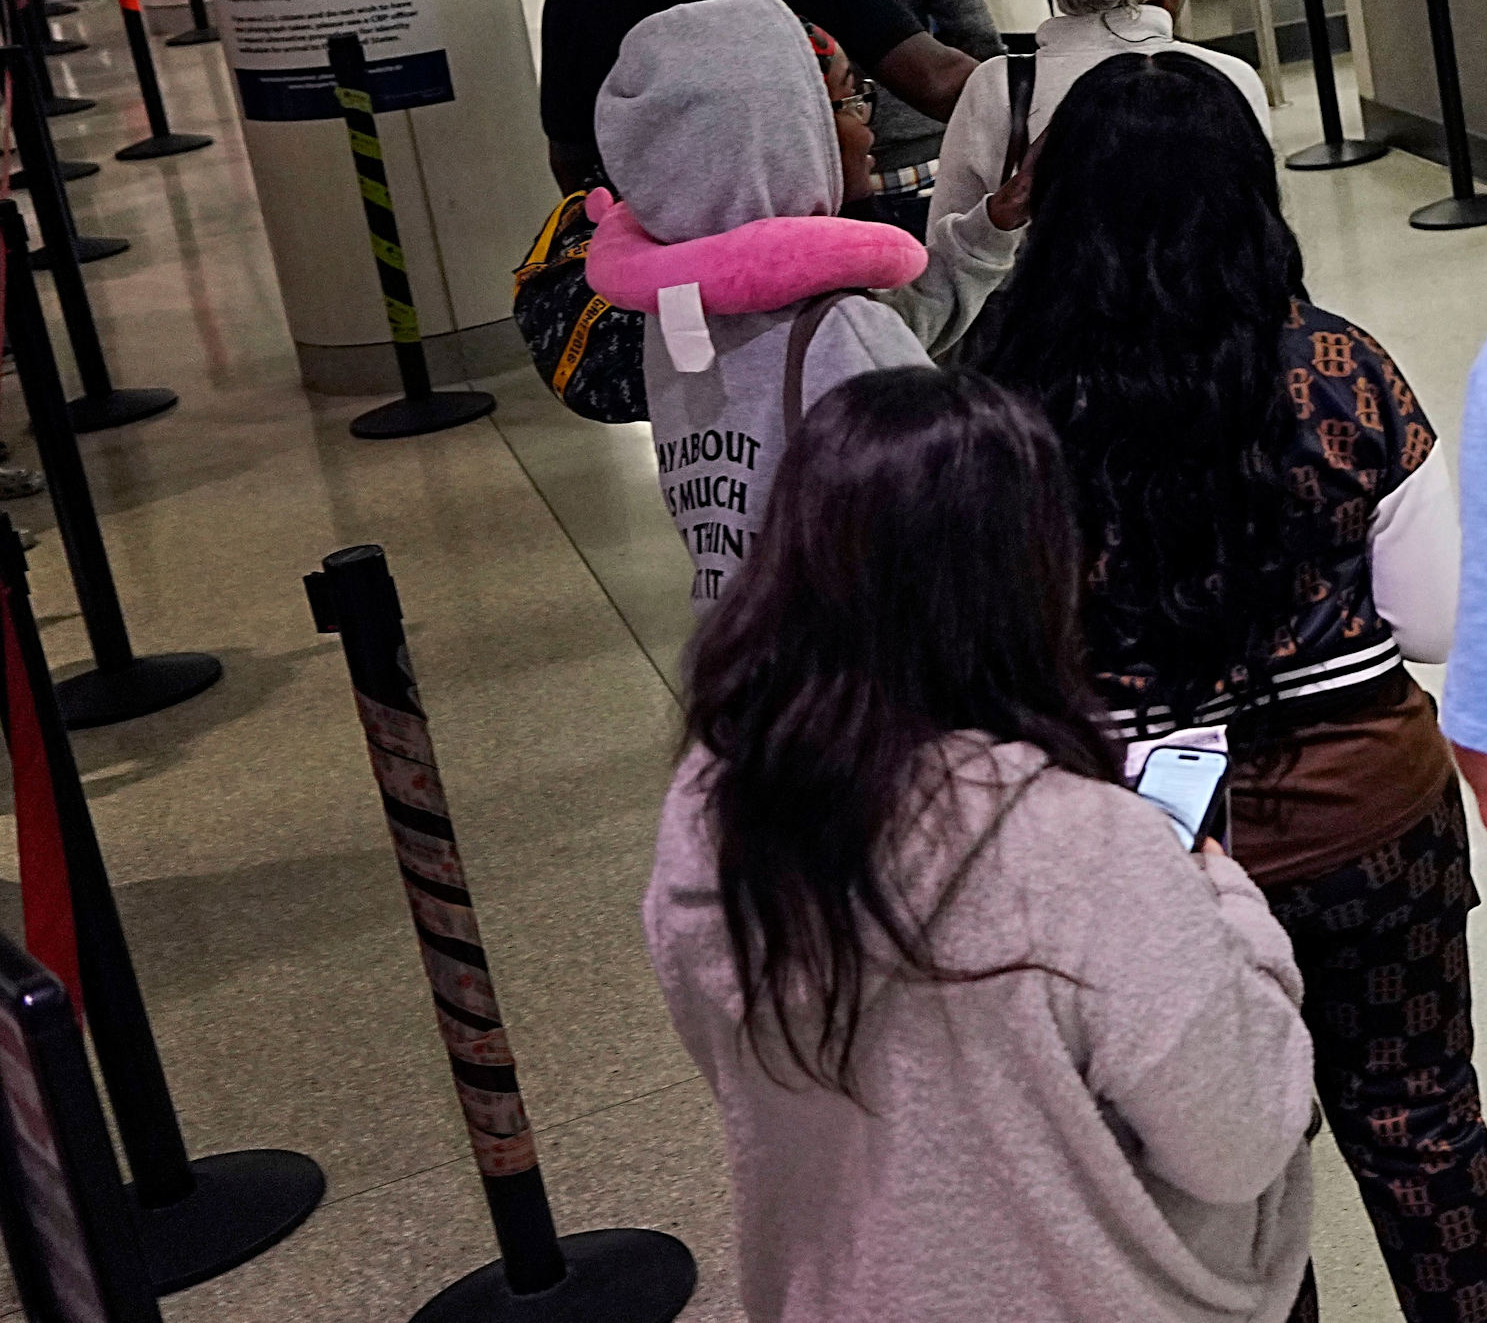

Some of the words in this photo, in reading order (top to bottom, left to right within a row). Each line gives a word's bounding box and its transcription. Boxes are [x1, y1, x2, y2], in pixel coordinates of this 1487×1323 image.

[657, 440, 678, 474] AY
[678, 429, 761, 471] ABOUT
[662, 484, 678, 518] S
[680, 475, 749, 516] MUCH
